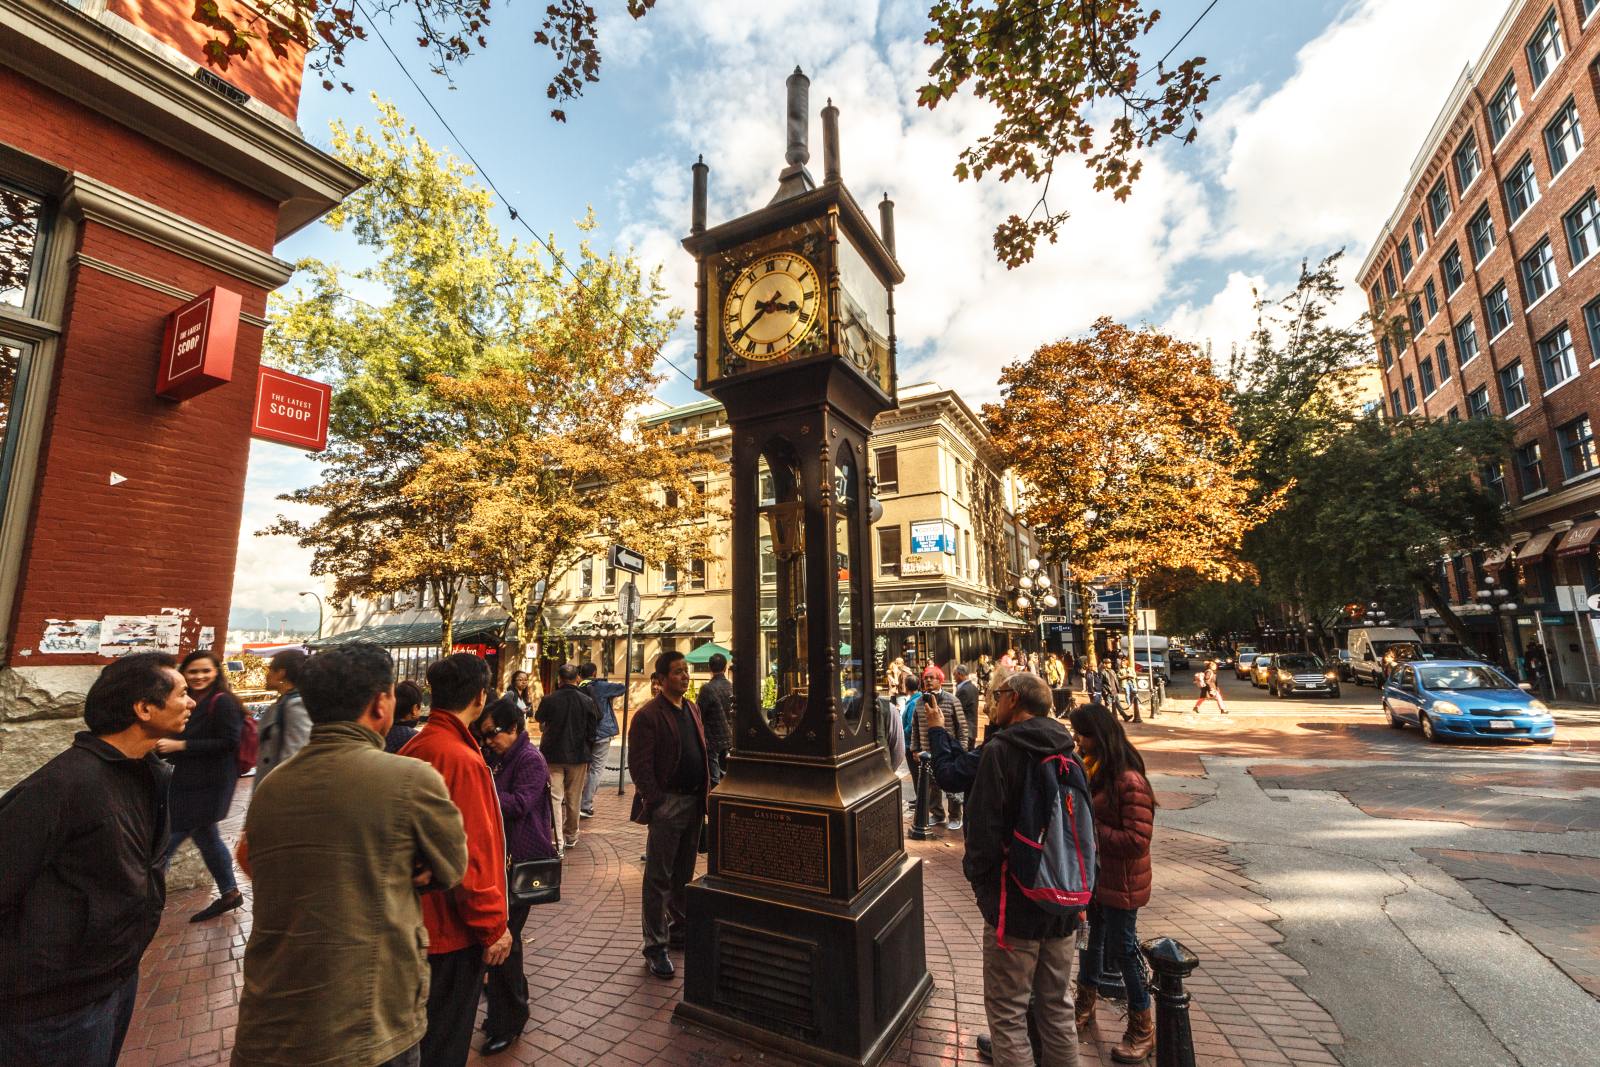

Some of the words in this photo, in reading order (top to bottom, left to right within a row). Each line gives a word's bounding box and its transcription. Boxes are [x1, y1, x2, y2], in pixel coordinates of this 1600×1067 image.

[177, 335, 199, 356] SCOOP
[271, 393, 284, 403] THE
[287, 397, 312, 409] LATEST
[270, 402, 311, 422] SCOOP
